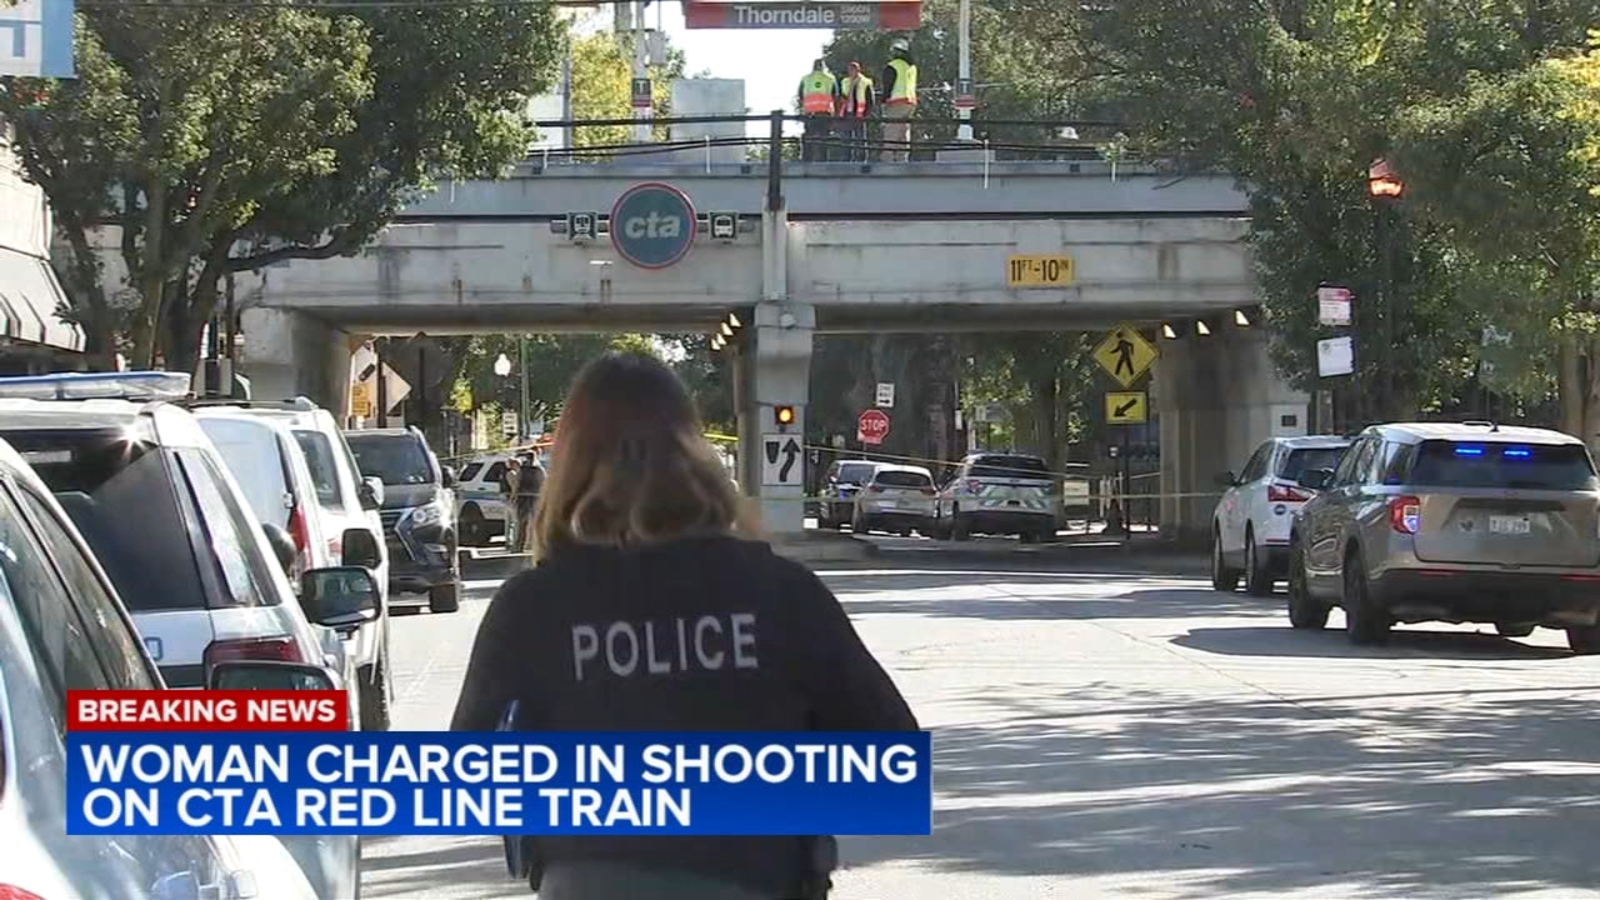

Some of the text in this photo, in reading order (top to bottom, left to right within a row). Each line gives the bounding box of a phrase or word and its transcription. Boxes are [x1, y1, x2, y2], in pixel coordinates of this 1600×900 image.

[734, 5, 835, 24] Thorndale
[624, 210, 681, 239] cta
[859, 419, 887, 431] STOP
[571, 613, 758, 681] POLICE
